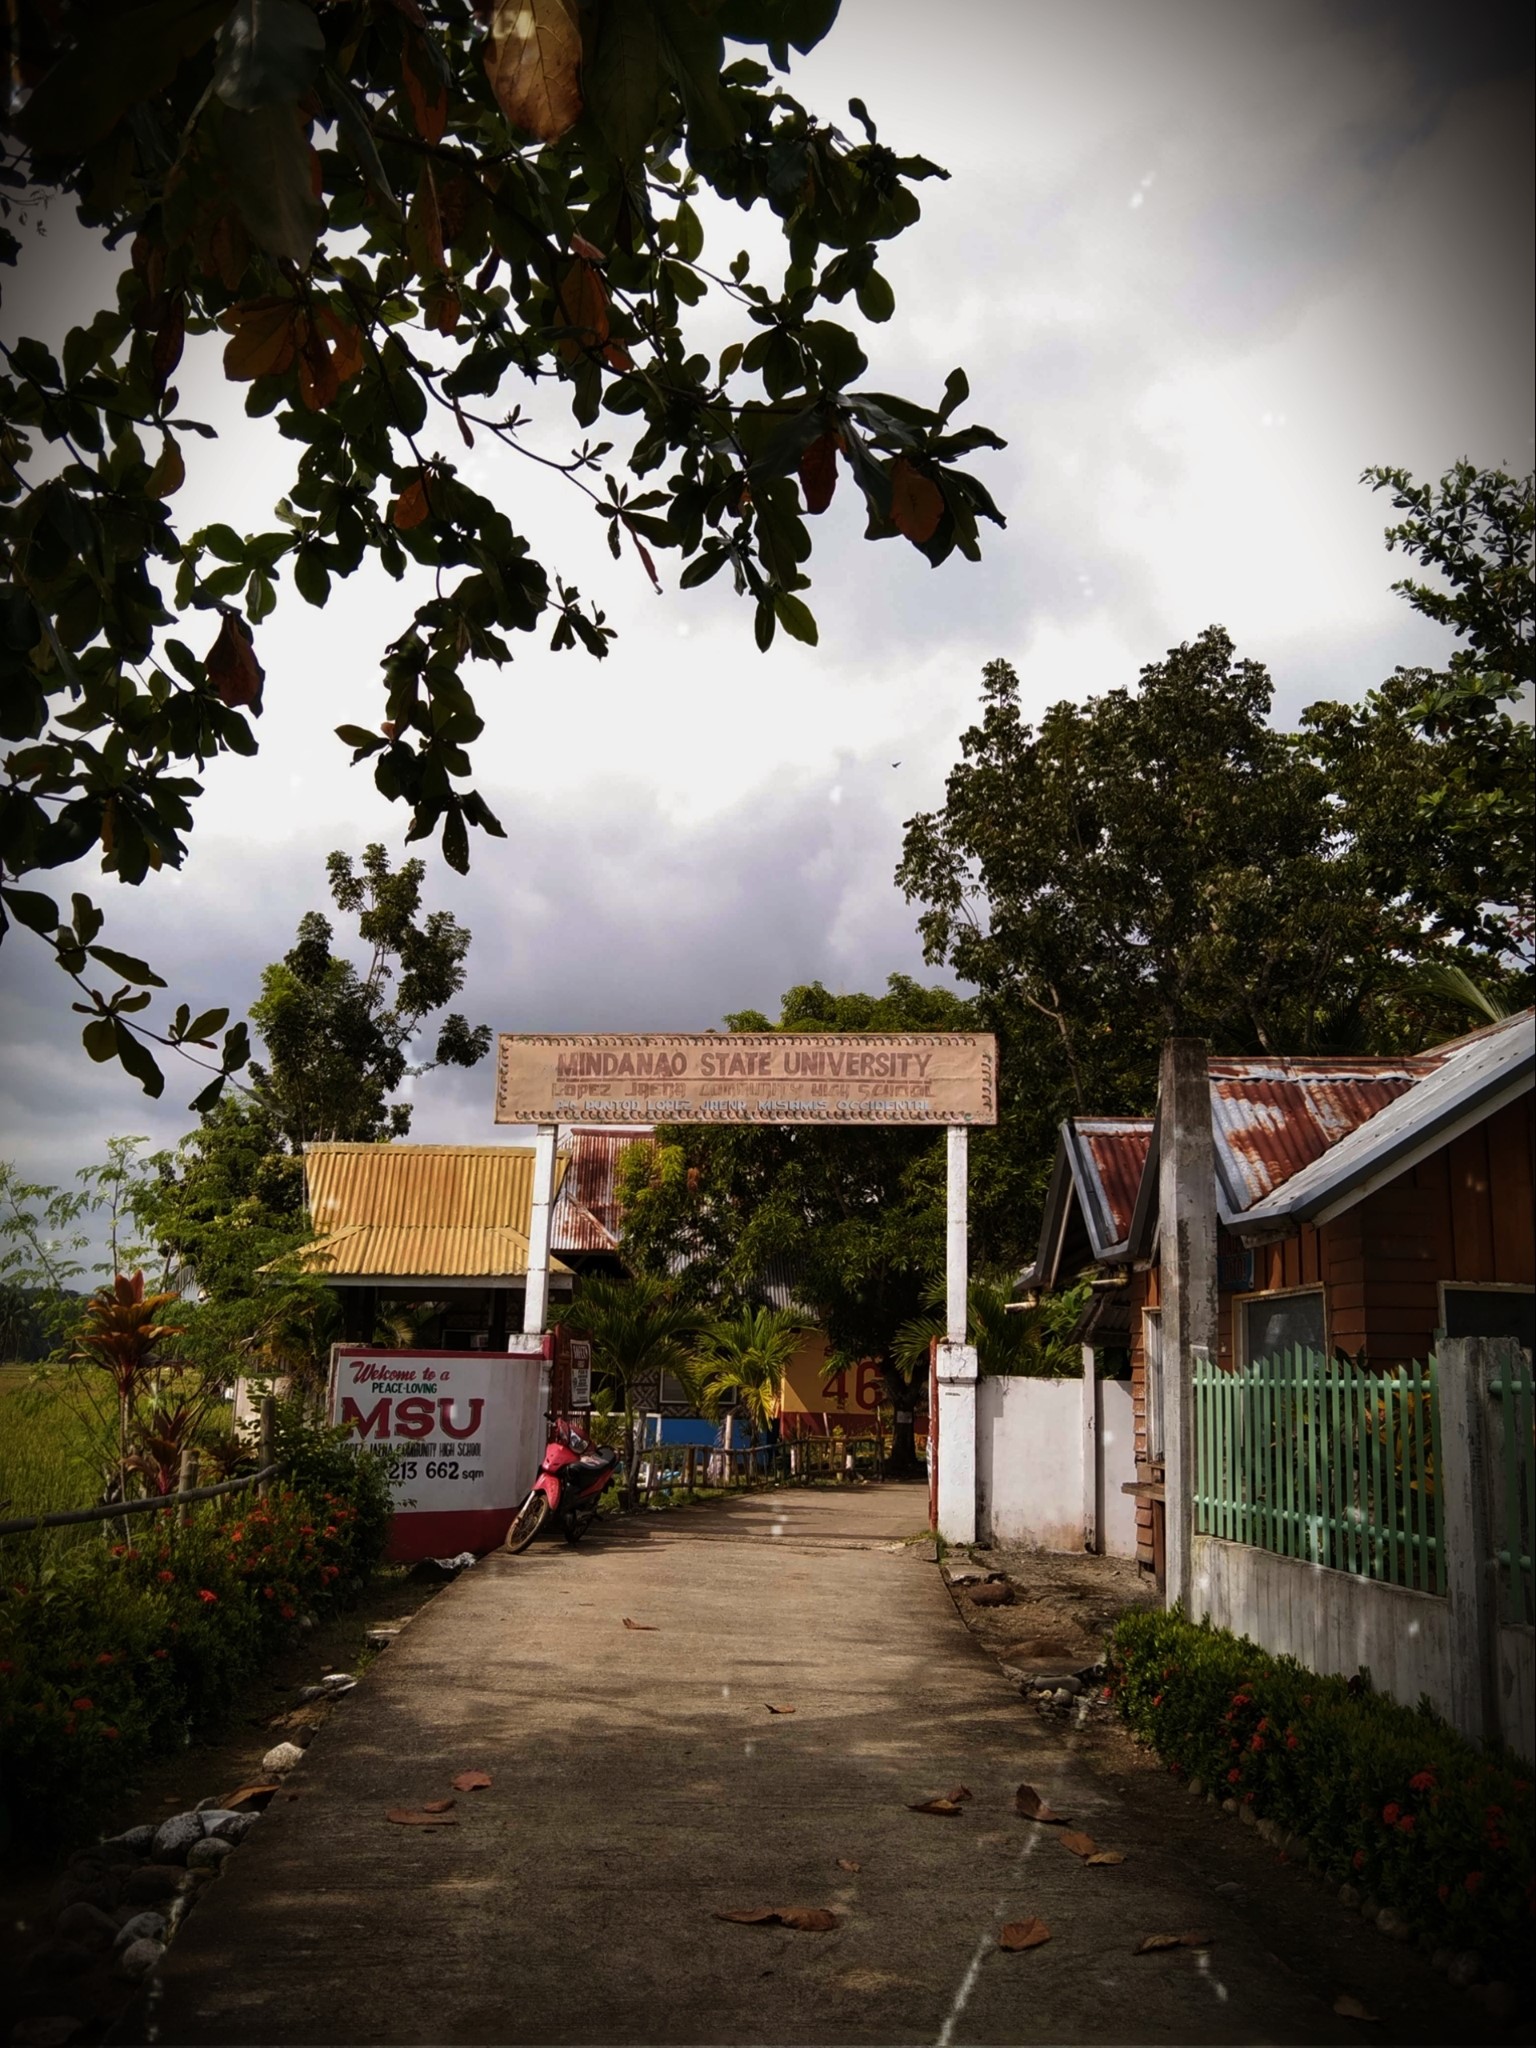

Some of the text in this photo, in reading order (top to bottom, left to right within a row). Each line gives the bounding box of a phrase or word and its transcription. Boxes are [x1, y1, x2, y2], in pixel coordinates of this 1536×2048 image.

[557, 1051, 933, 1078] MINDANAO STATE UNIVERSITY
[551, 1082, 613, 1100] LOPEZ
[810, 1083, 850, 1099] HIGH
[857, 1083, 937, 1099] SCHOOL
[646, 1100, 693, 1112] LOPEZ
[756, 1100, 830, 1112] MISAMIS
[836, 1100, 934, 1112] OCCIDENTAL
[349, 1361, 451, 1384] Welcome to a
[371, 1382, 438, 1394] PEACE-LOVING
[822, 1361, 884, 1411] 46
[341, 1396, 485, 1440] MSU
[438, 1443, 456, 1457] HIGH
[457, 1443, 481, 1457] SCHOOL
[425, 1461, 459, 1480] 662
[462, 1468, 484, 1484] sqm
